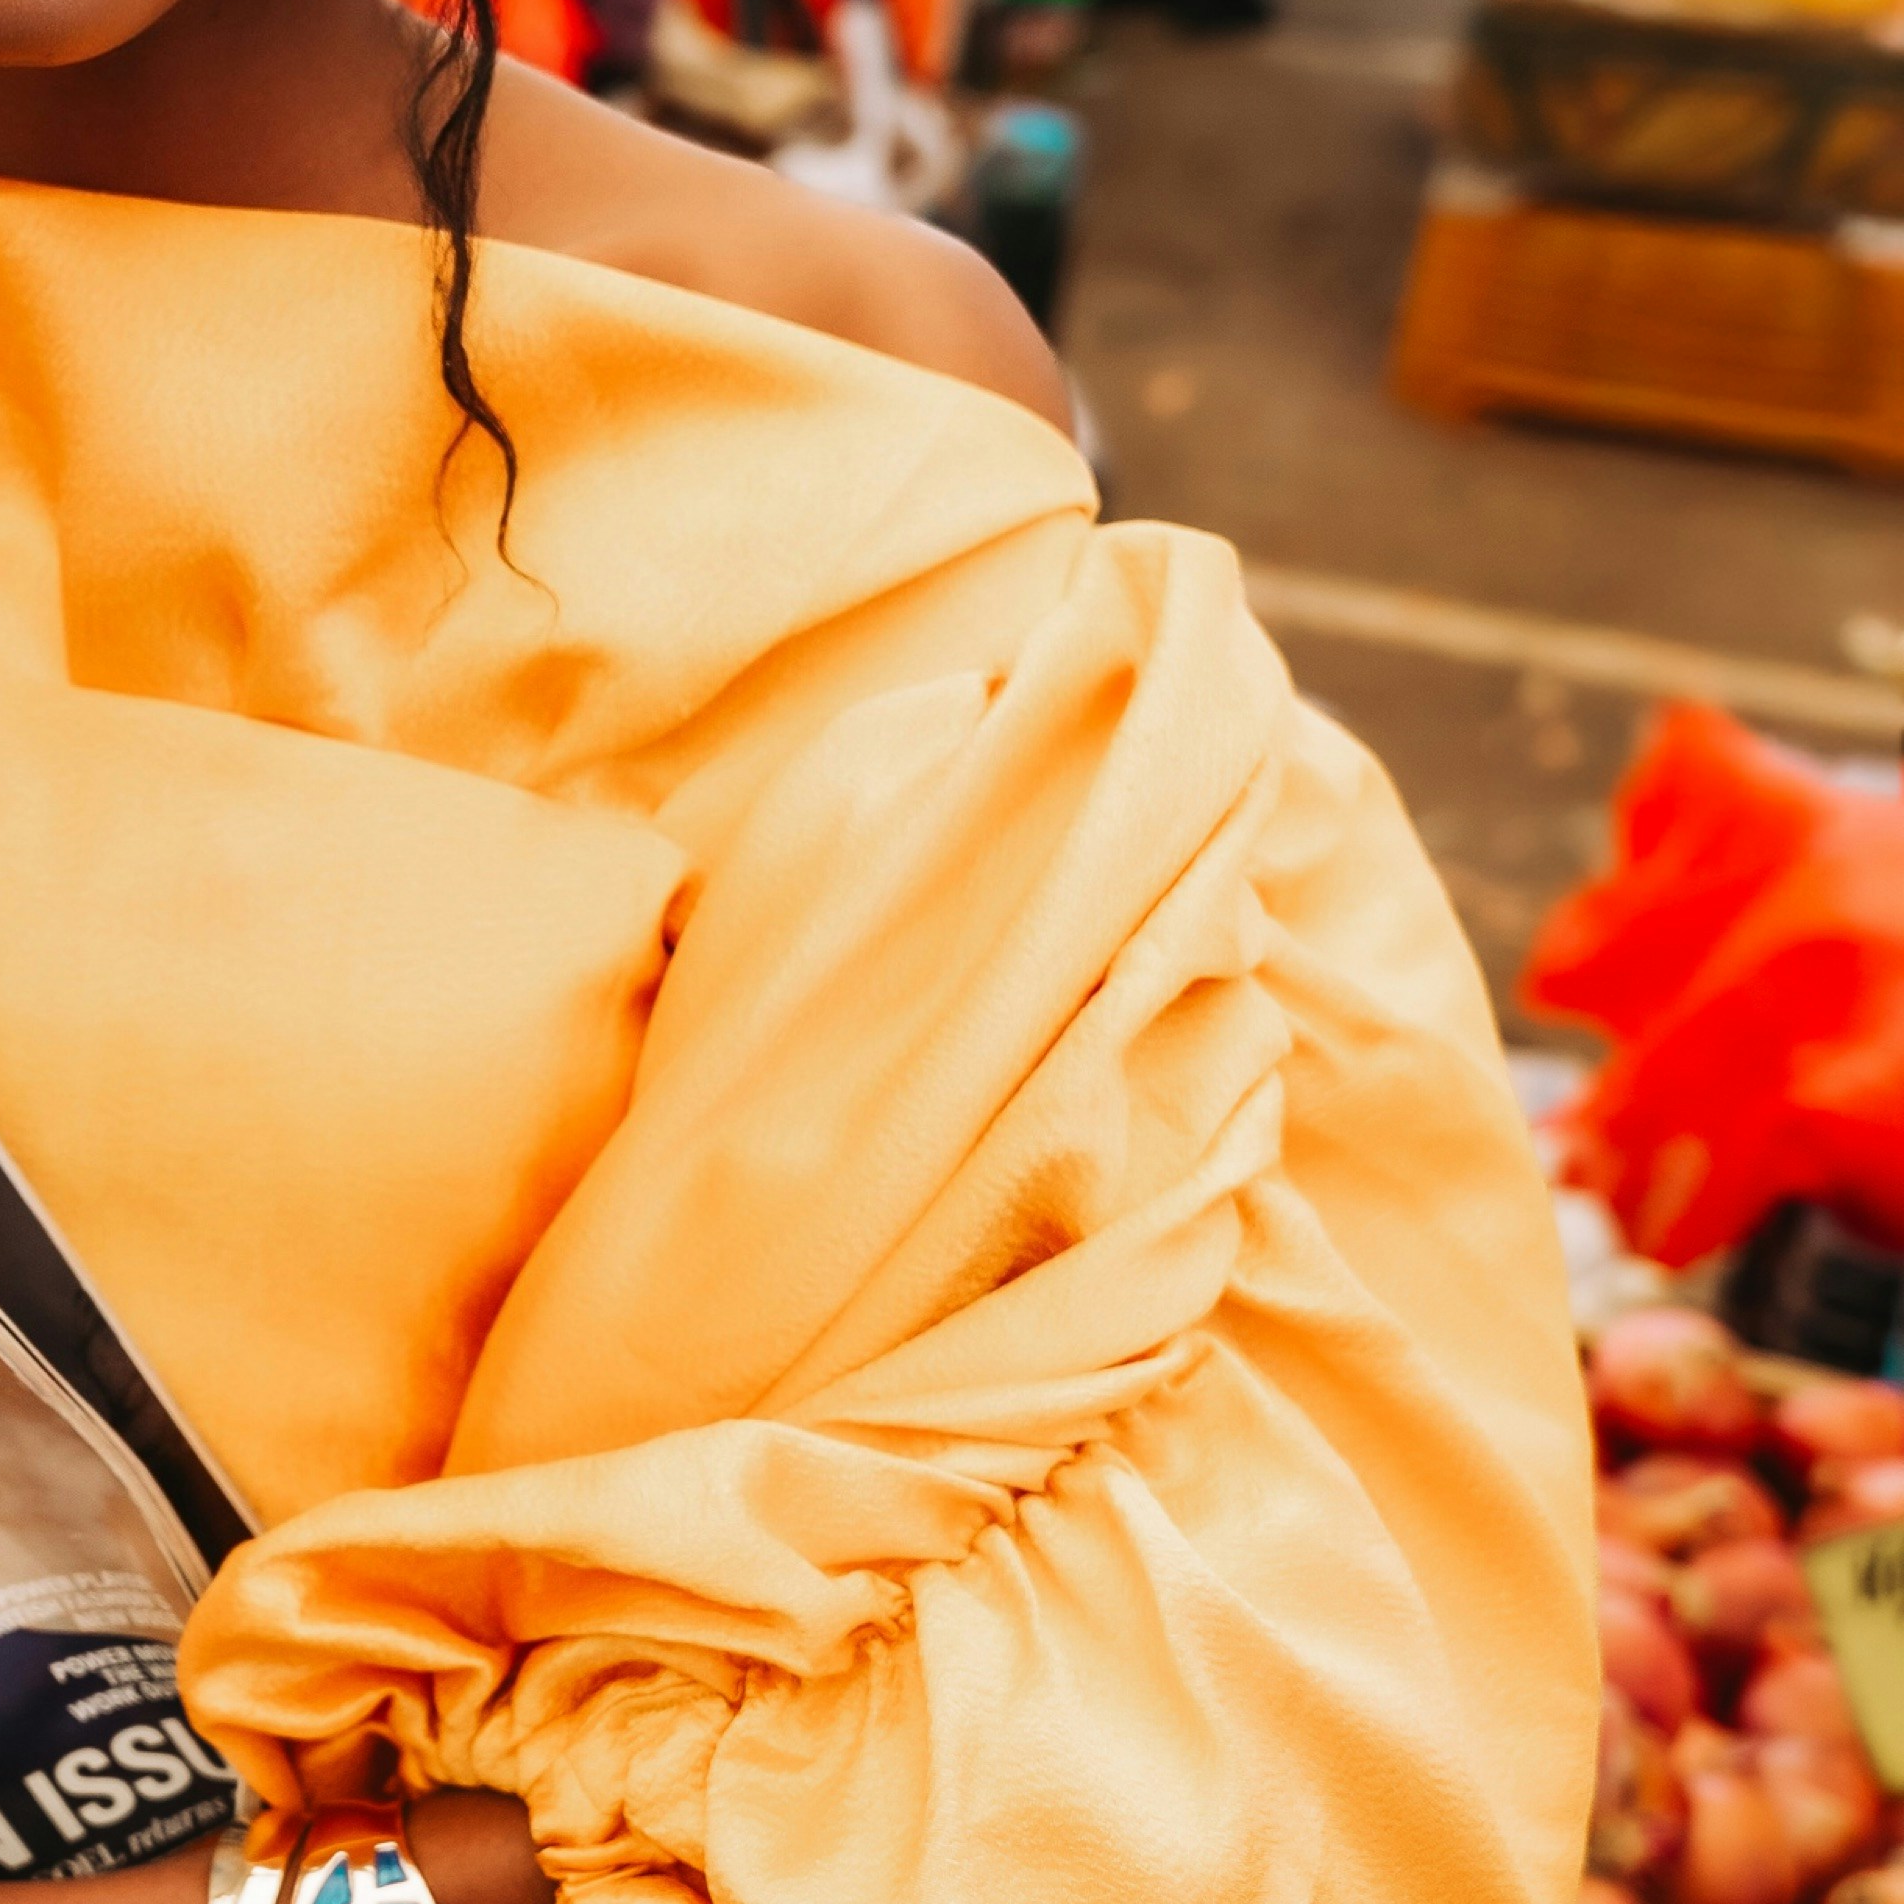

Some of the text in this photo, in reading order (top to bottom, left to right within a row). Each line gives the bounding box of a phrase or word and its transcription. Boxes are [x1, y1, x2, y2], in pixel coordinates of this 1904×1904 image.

[48, 1645, 135, 1685] POWER
[66, 1685, 143, 1724] WORK
[23, 1715, 241, 1844] ISSU
